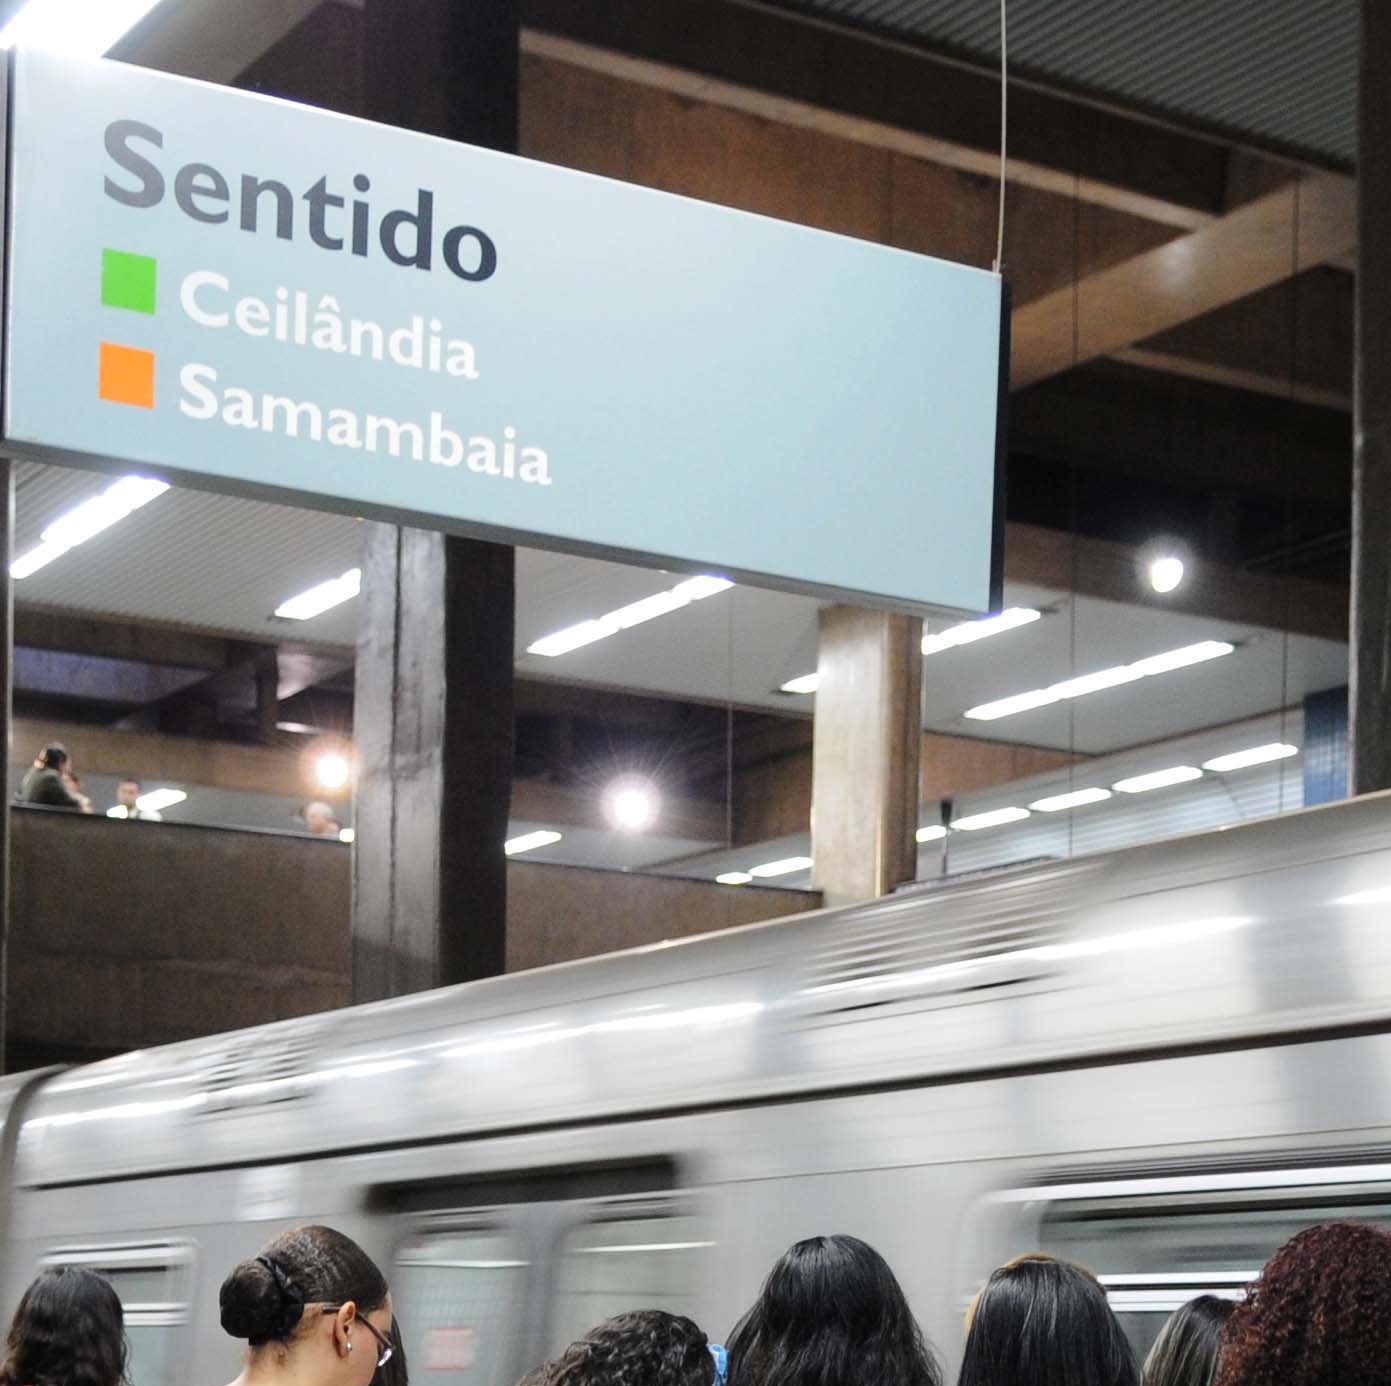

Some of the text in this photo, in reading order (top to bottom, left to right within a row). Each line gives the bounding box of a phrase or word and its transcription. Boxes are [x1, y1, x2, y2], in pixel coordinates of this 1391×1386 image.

[103, 118, 498, 283] Sentido
[179, 271, 480, 379] Ceilândia
[179, 363, 552, 486] Samambaia
